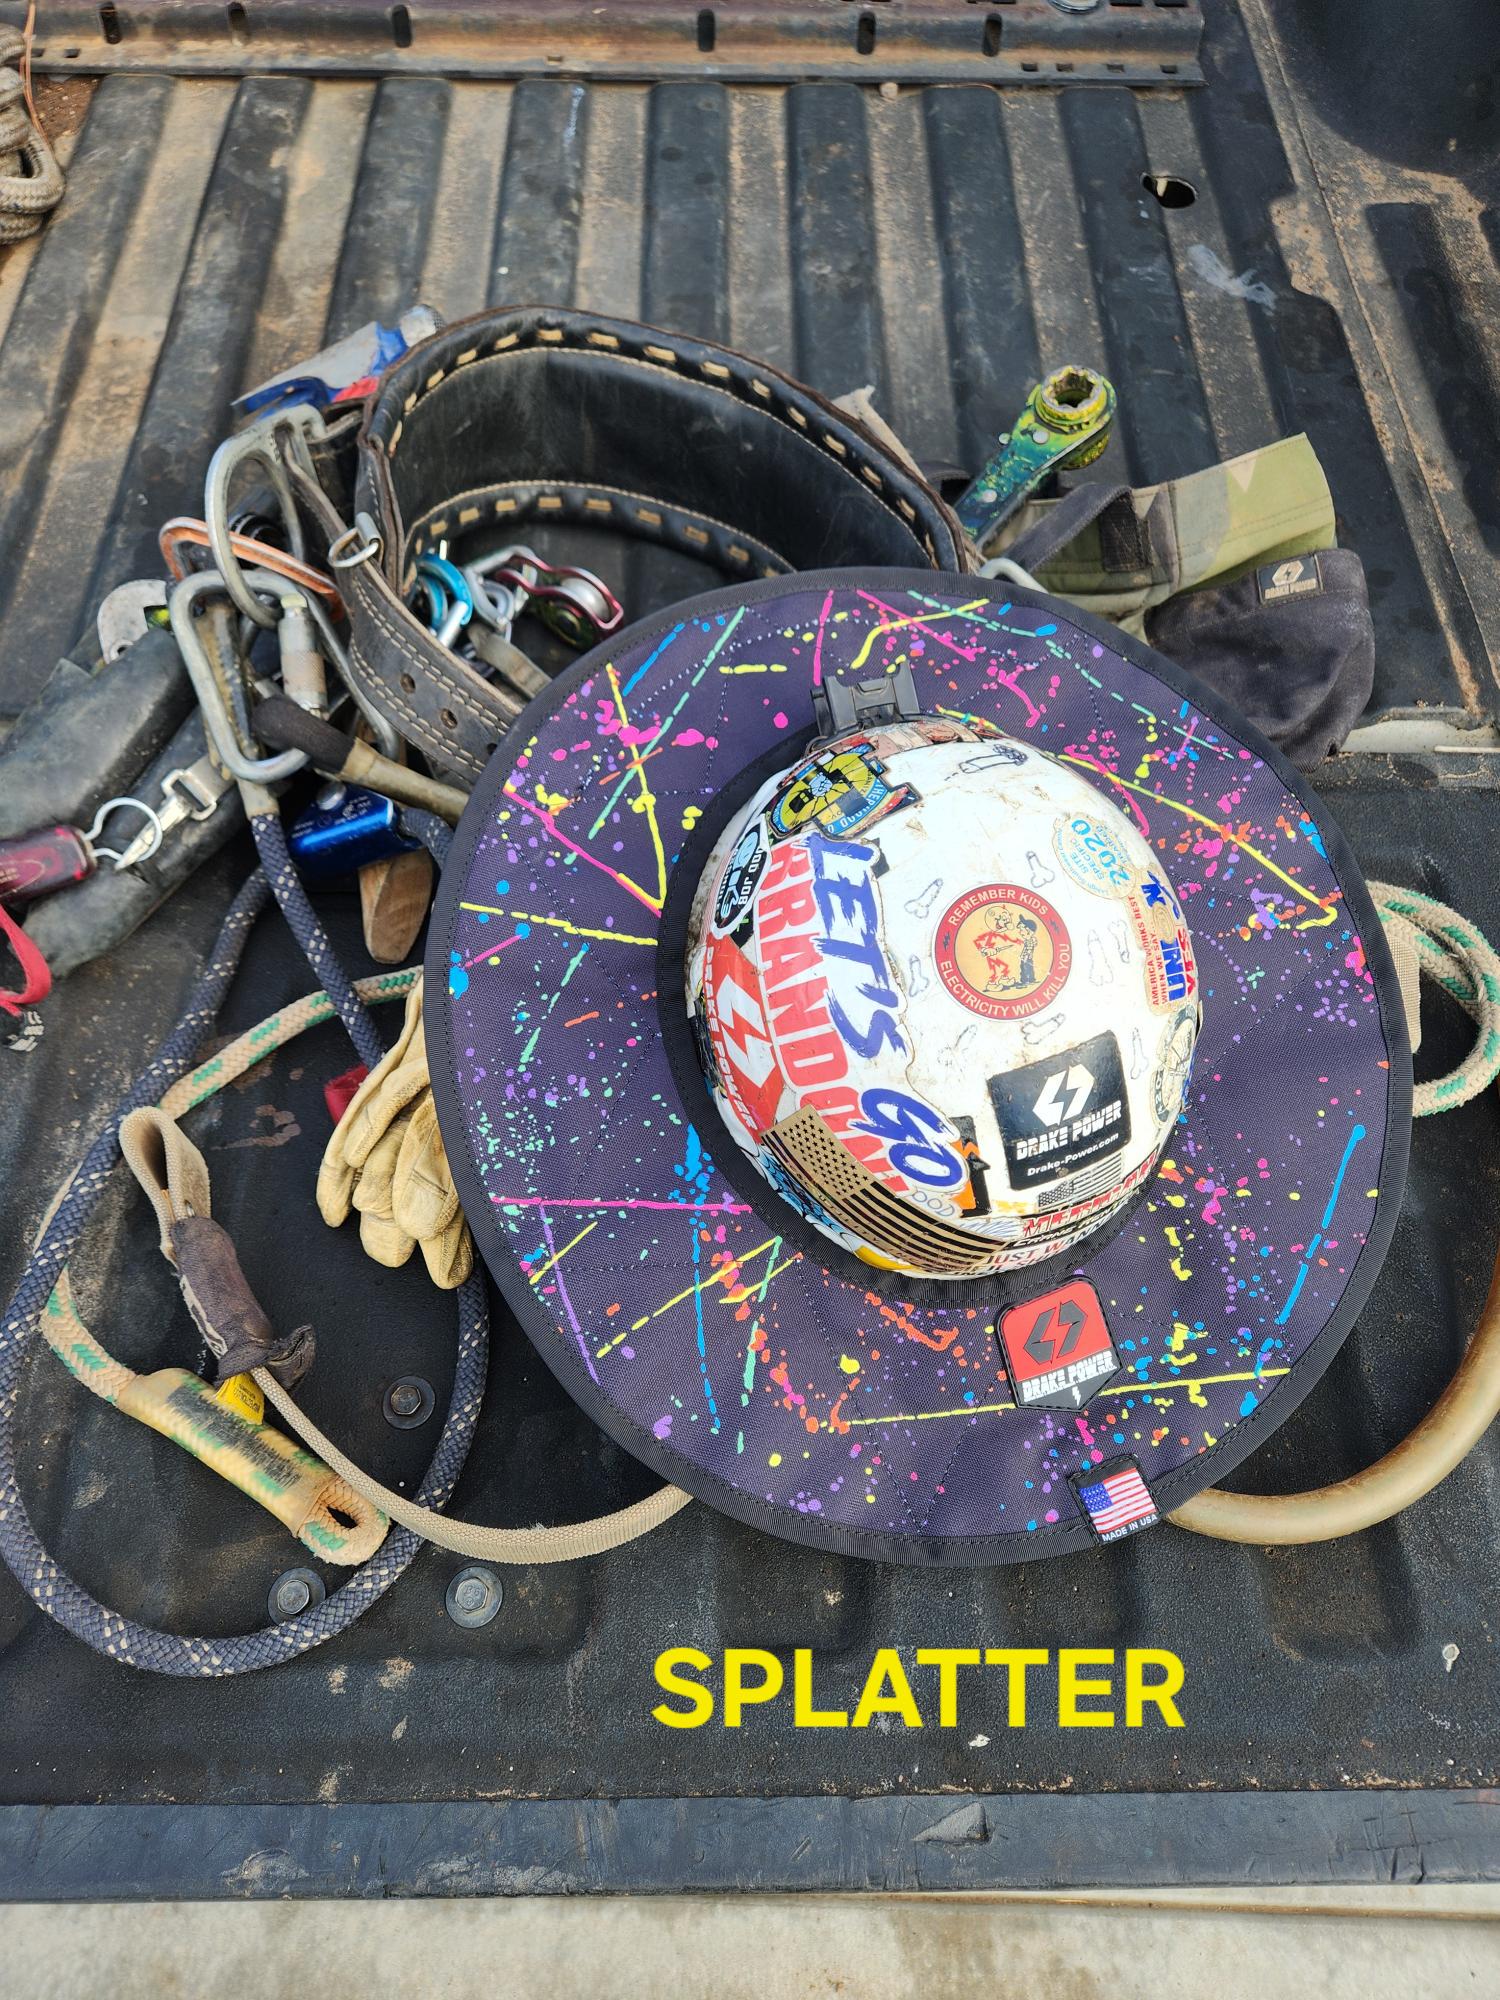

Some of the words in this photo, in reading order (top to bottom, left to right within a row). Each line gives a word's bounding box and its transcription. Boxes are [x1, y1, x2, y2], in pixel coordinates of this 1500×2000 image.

[1071, 819, 1130, 886] 2020
[738, 876, 753, 905] JOB
[948, 888, 1016, 926] REMEMBER
[1020, 892, 1049, 915] KIDS
[1128, 895, 1143, 920] BEST
[799, 831, 908, 1059] LET'S
[1137, 921, 1153, 959] WORKS
[1155, 955, 1165, 968] WE
[940, 960, 1010, 1017] ELECTRICITY
[1012, 998, 1046, 1017] WILL
[1042, 974, 1067, 1001] KILL
[1058, 943, 1071, 971] YOU
[1144, 959, 1160, 1006] AMERICA
[1156, 968, 1168, 1005] WHEN
[704, 946, 720, 1032] DRAKE
[714, 1040, 758, 1130] POWER
[850, 1088, 963, 1187] GO
[1016, 1126, 1069, 1160] DRAKE
[1072, 1100, 1122, 1142] POWER
[1027, 1132, 1119, 1176] Drake-Power.com
[985, 1249, 1037, 1265] JUST
[1022, 1369, 1067, 1402] DRAKE
[1066, 1350, 1118, 1387] POWER
[1101, 1526, 1128, 1542] MADE
[1129, 1521, 1139, 1532] IN
[1139, 1513, 1158, 1526] USA
